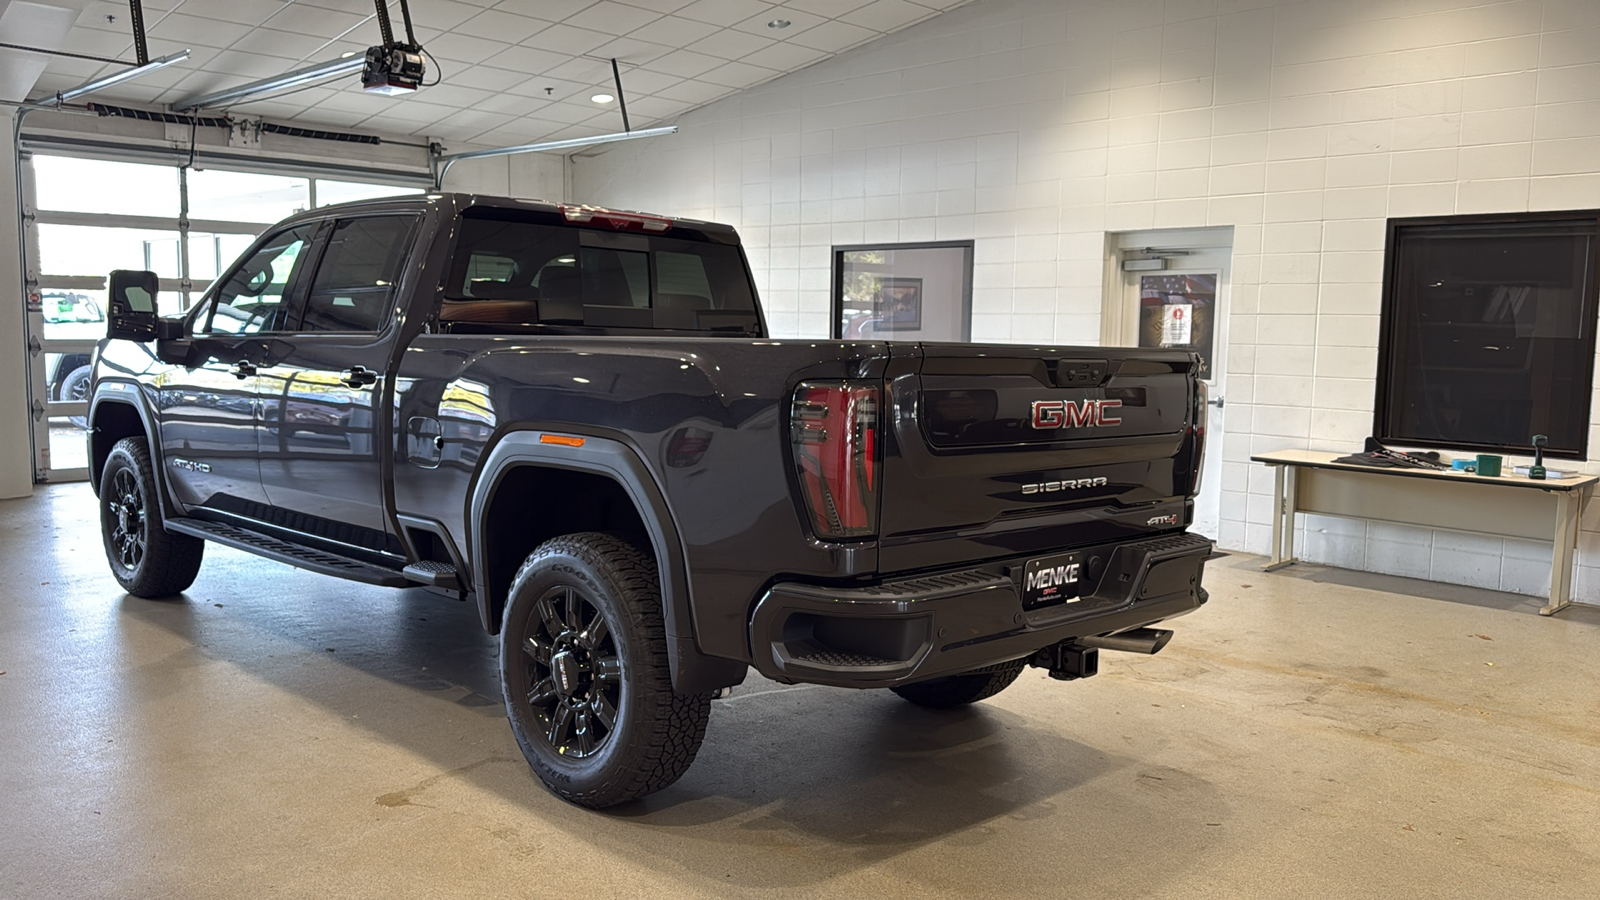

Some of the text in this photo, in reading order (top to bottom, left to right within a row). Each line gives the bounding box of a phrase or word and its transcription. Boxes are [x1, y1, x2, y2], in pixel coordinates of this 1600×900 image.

[1032, 399, 1122, 429] GMC
[1021, 476, 1108, 495] SIERRA
[1146, 513, 1178, 526] AT4
[1026, 563, 1080, 592] MENKE
